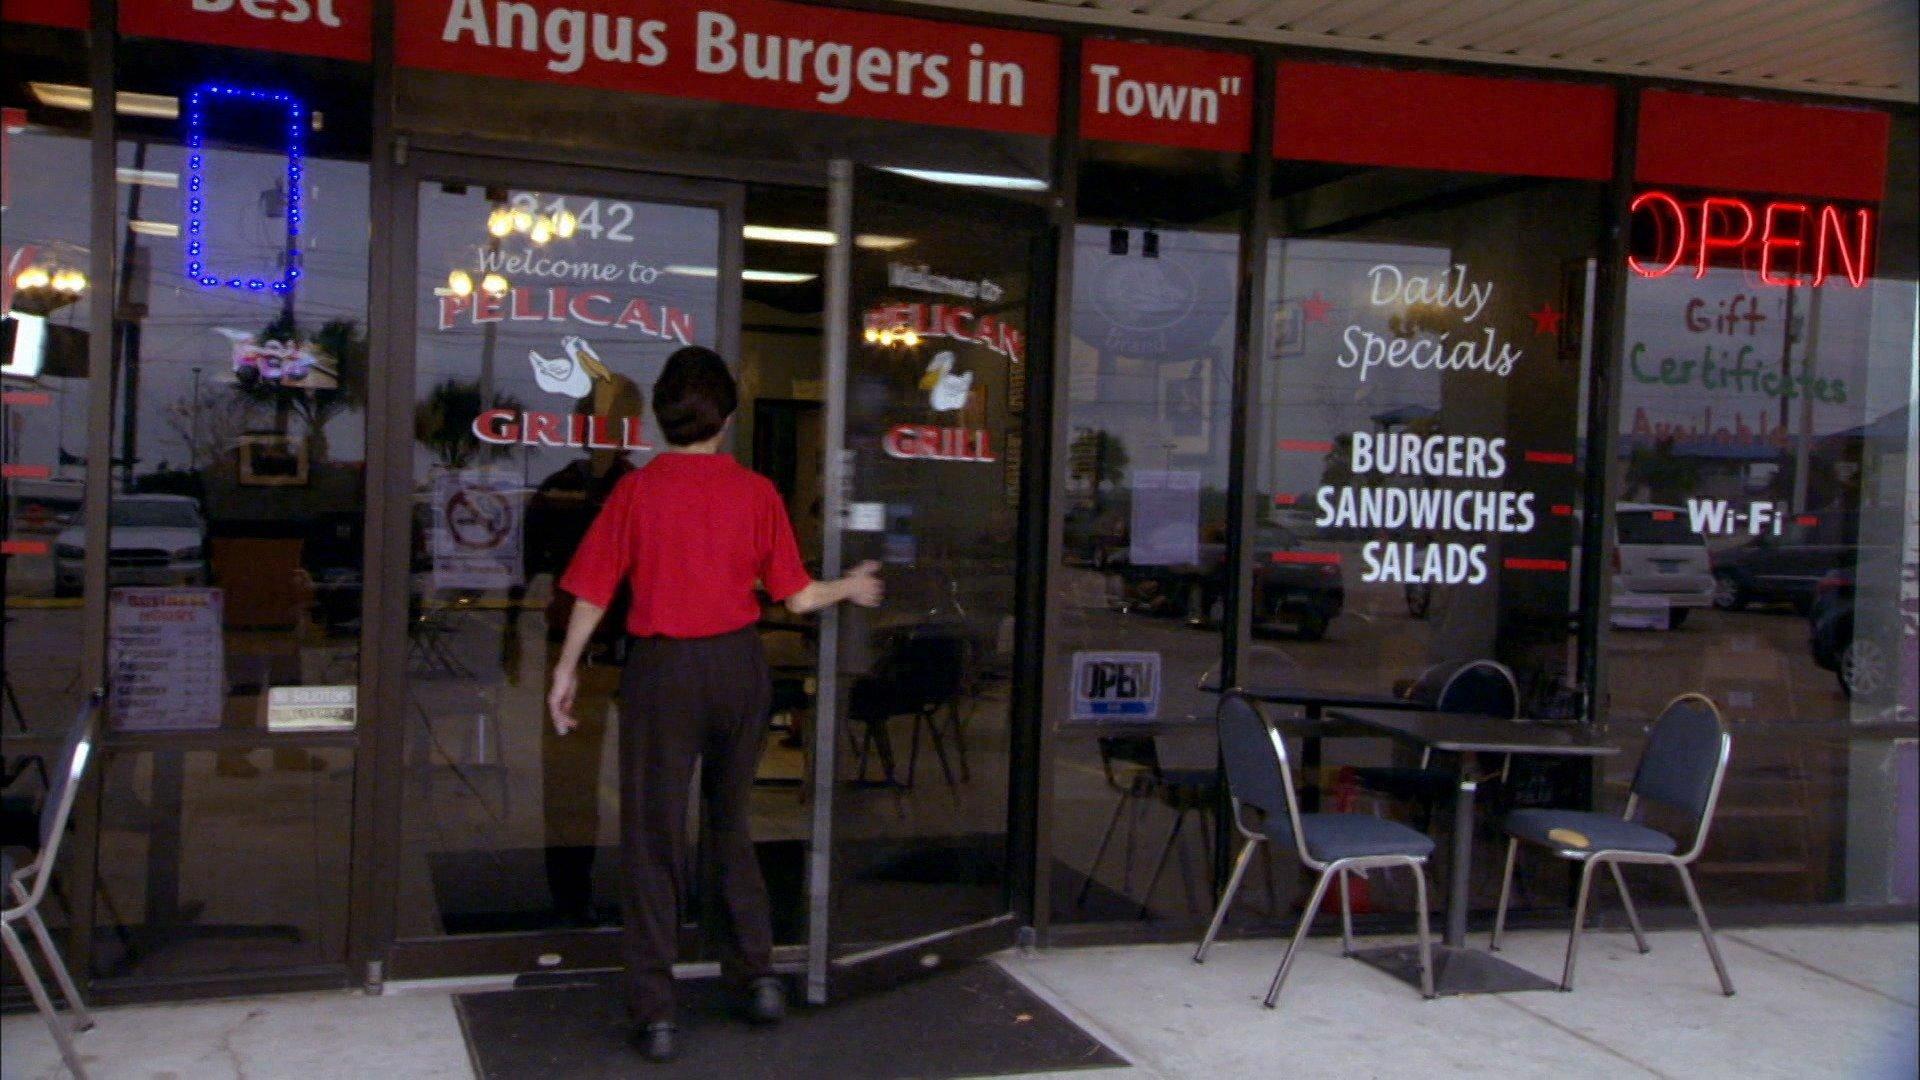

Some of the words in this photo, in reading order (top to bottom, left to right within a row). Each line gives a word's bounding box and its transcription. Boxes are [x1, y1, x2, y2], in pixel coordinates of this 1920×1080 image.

[442, 0, 668, 73] Angus
[696, 10, 951, 104] Burgers
[968, 43, 1024, 107] in
[1627, 190, 1869, 288] OPEN
[475, 249, 625, 281] Welcome
[628, 261, 662, 284] to
[438, 284, 695, 346] PELICAN
[1367, 263, 1494, 323] Daily
[1685, 294, 1766, 336] Gift
[1337, 325, 1523, 382] Specials
[1630, 342, 1847, 400] Certificates
[472, 408, 655, 451] GRILL
[881, 423, 997, 463] GRILL
[1351, 431, 1507, 478] BURGERS
[1315, 485, 1536, 533] SANDWICHES
[1688, 499, 1784, 536] Wi-Fi
[1361, 541, 1488, 584] SALADS
